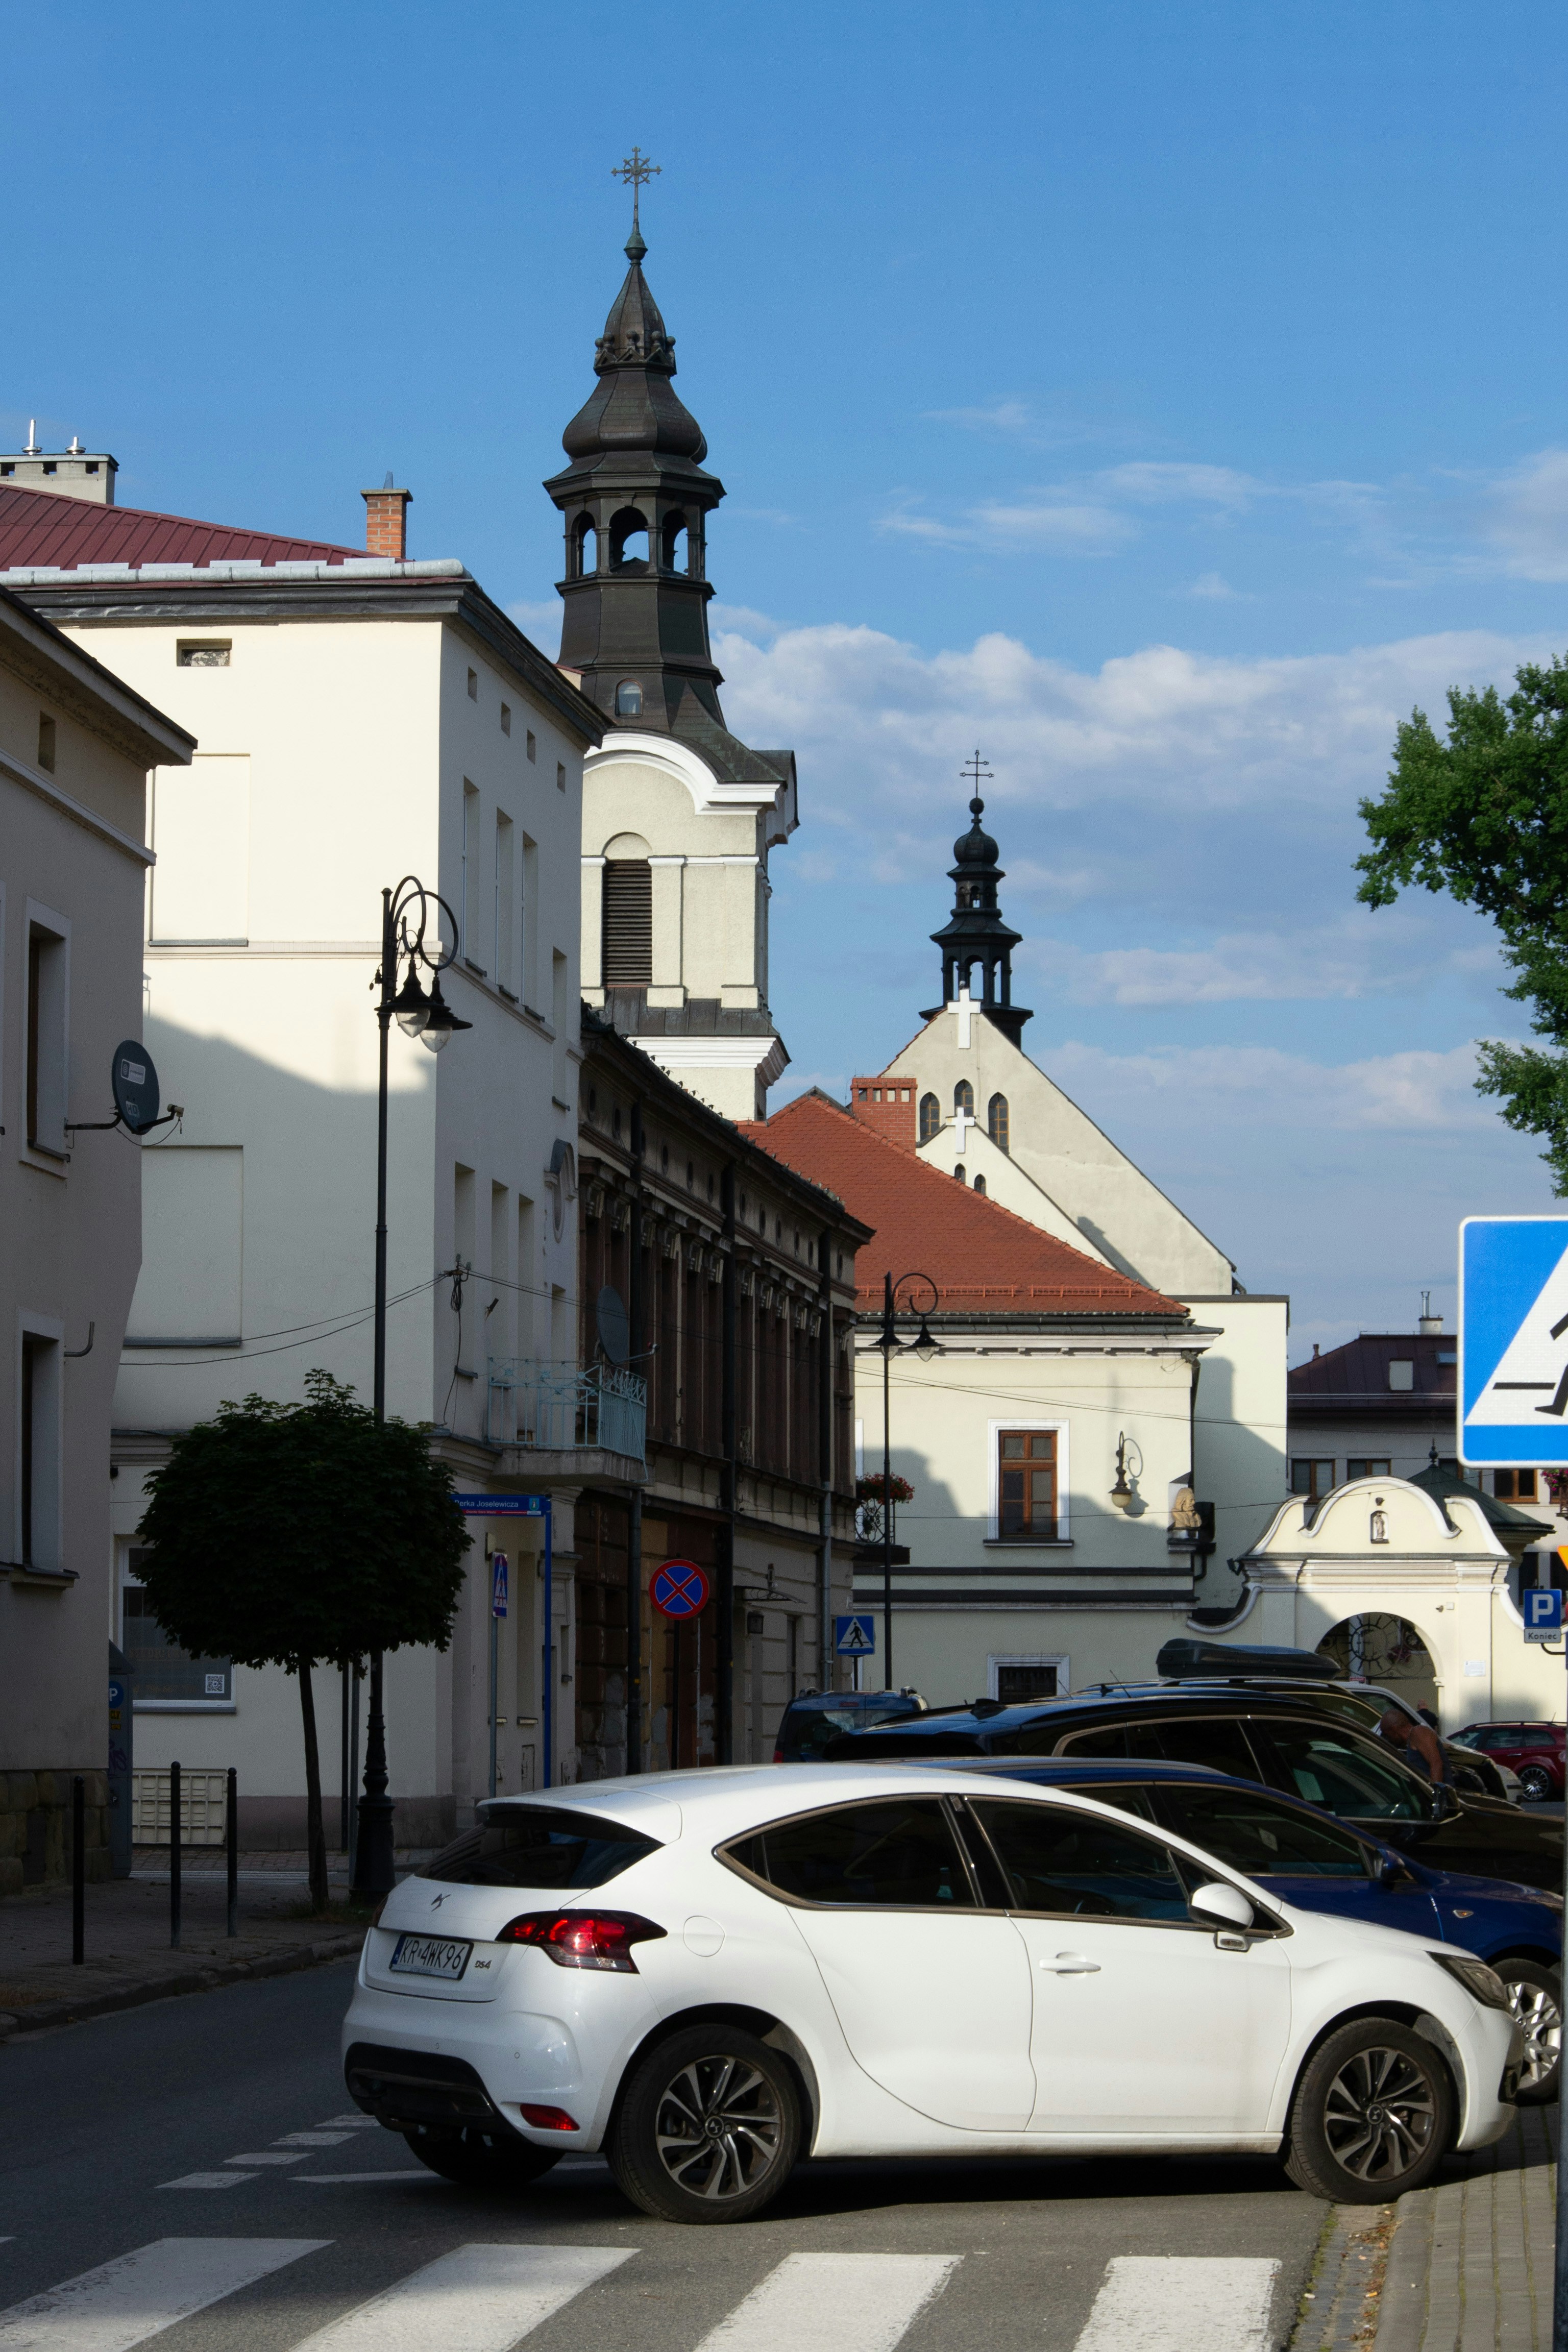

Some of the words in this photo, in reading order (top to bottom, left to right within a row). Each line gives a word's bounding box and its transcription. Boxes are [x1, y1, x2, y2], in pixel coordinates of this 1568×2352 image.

[127, 1103, 138, 1114] HD
[476, 1500, 519, 1508] Joselewicza
[1532, 1594, 1554, 1624] P
[109, 1687, 118, 1702] P
[400, 1940, 419, 1964] KR
[421, 1942, 465, 1969] 4WK96
[475, 1960, 492, 1969] DS4
